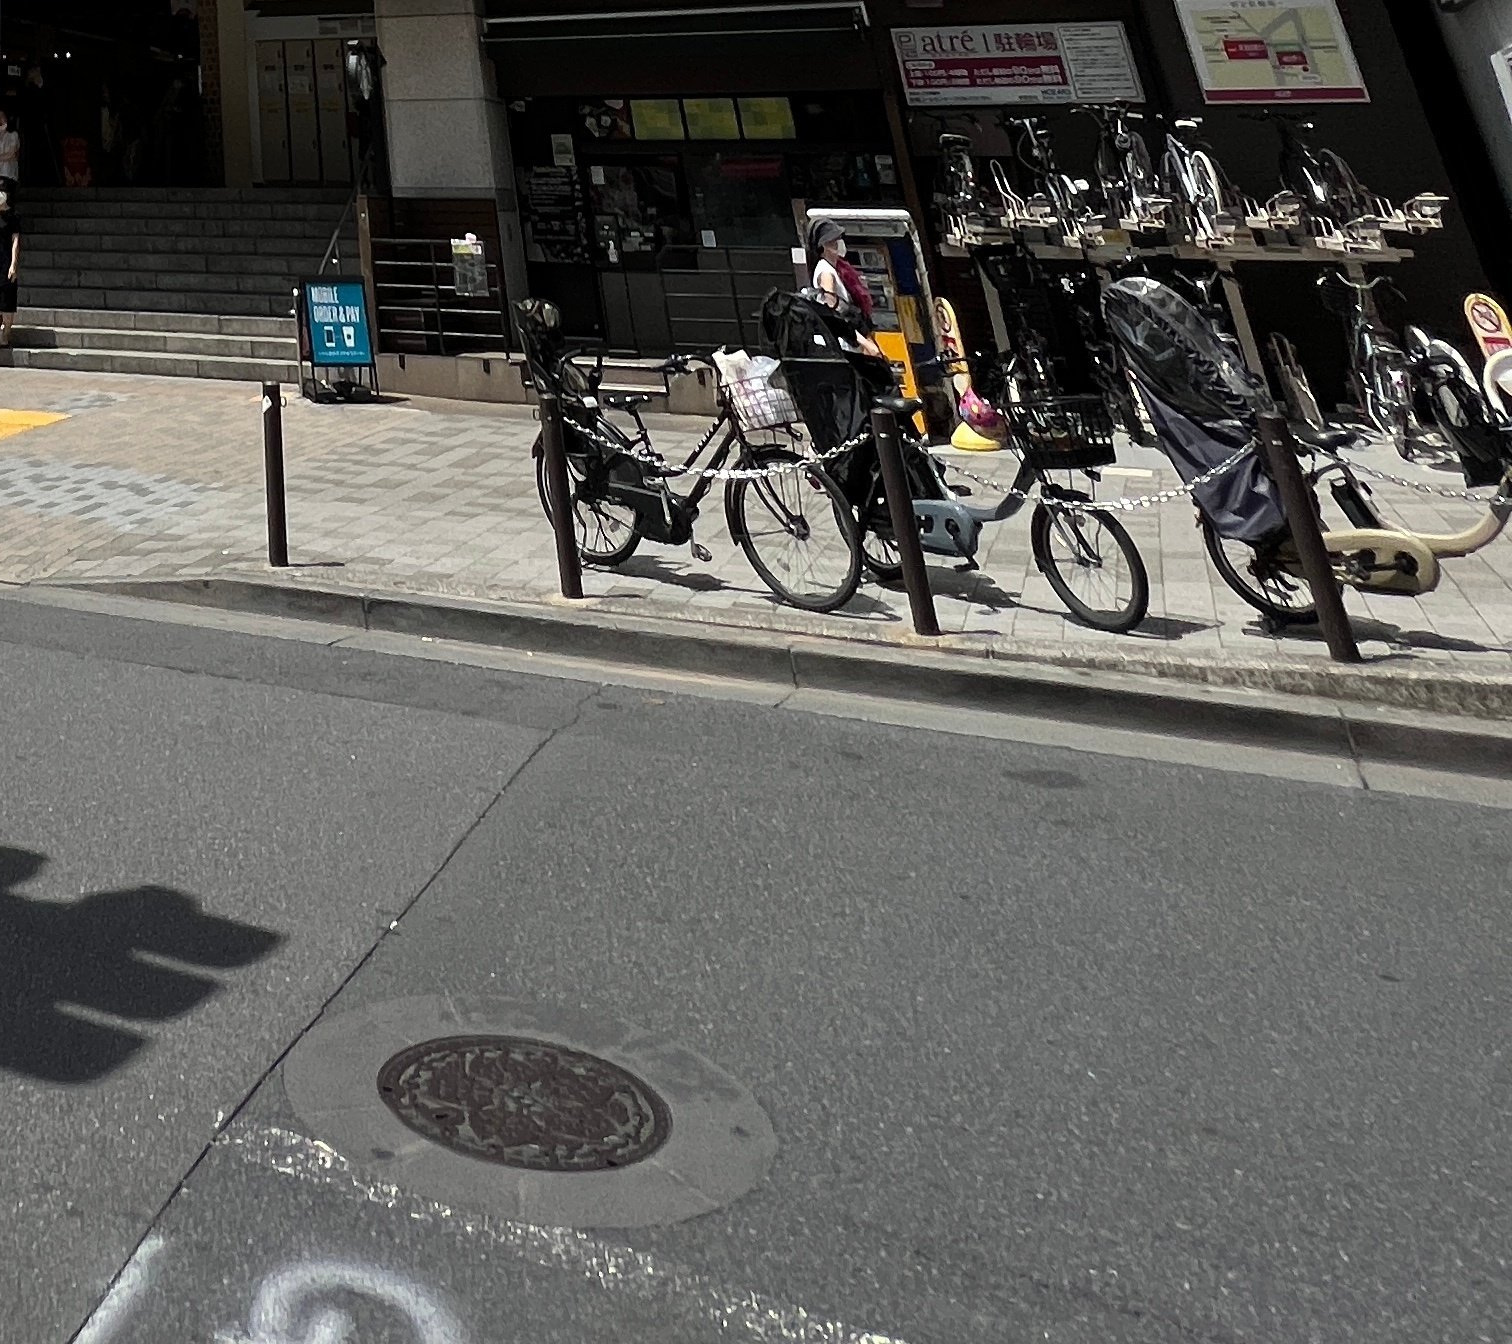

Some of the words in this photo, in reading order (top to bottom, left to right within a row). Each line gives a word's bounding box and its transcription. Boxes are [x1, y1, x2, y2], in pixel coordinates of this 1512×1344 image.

[311, 286, 339, 304] MOBILE
[313, 305, 338, 323] ORDER
[345, 305, 360, 323] PAY
